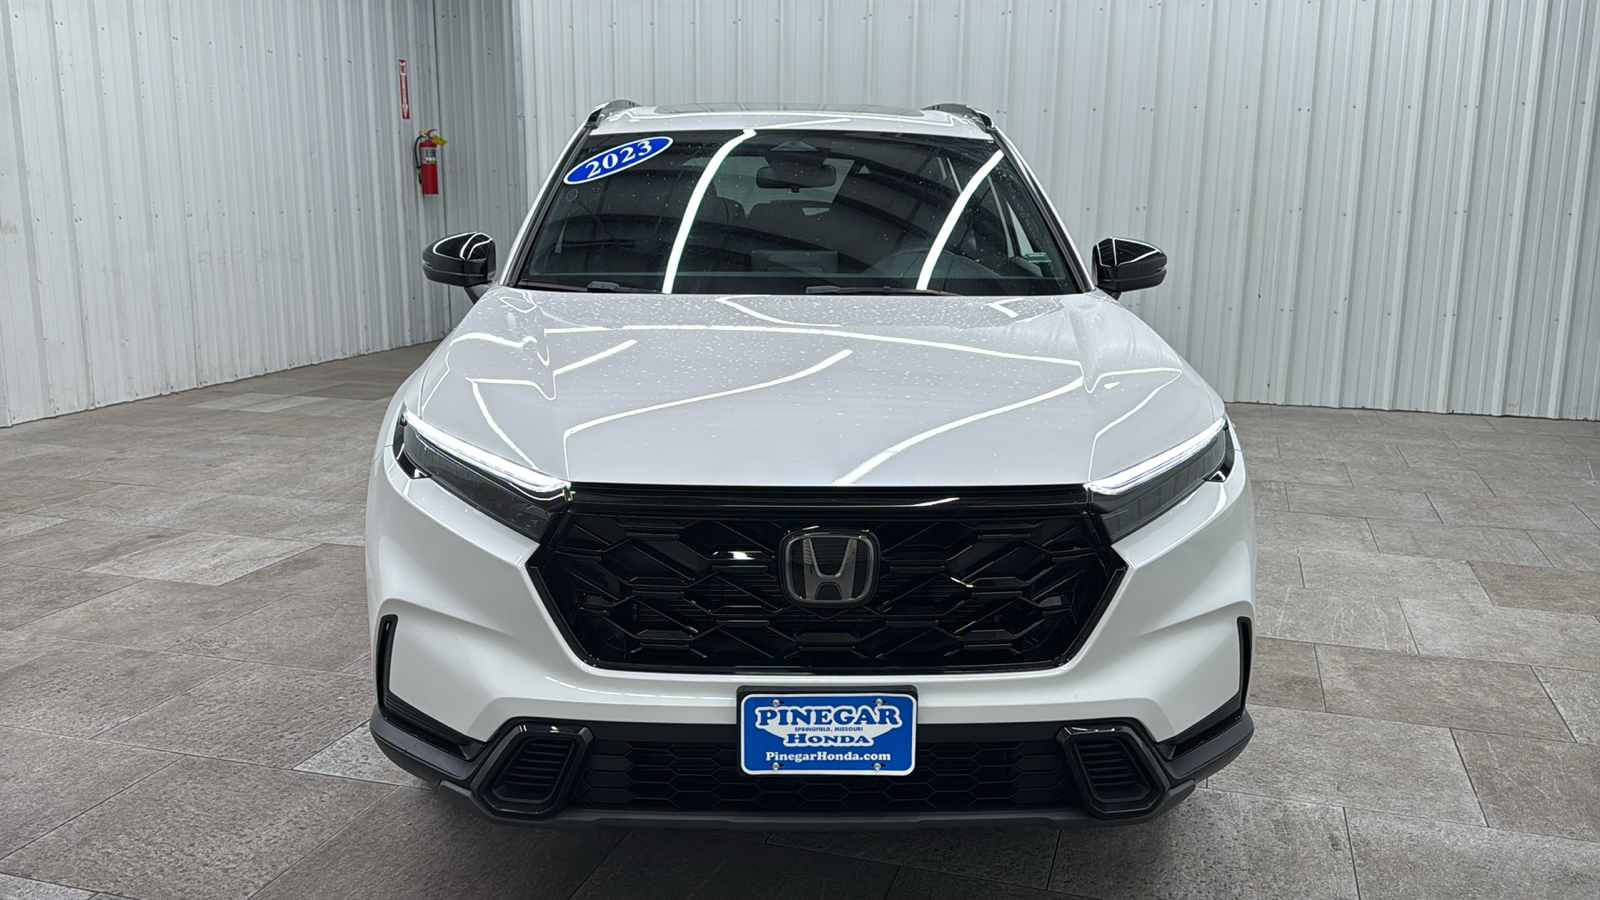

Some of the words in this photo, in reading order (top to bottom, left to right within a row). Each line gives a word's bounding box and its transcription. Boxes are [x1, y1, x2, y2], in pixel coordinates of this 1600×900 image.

[585, 140, 652, 179] 2023
[758, 708, 899, 725] PINEGAR
[787, 733, 870, 744] HONDA
[765, 751, 891, 763] PinegarHonda.com
